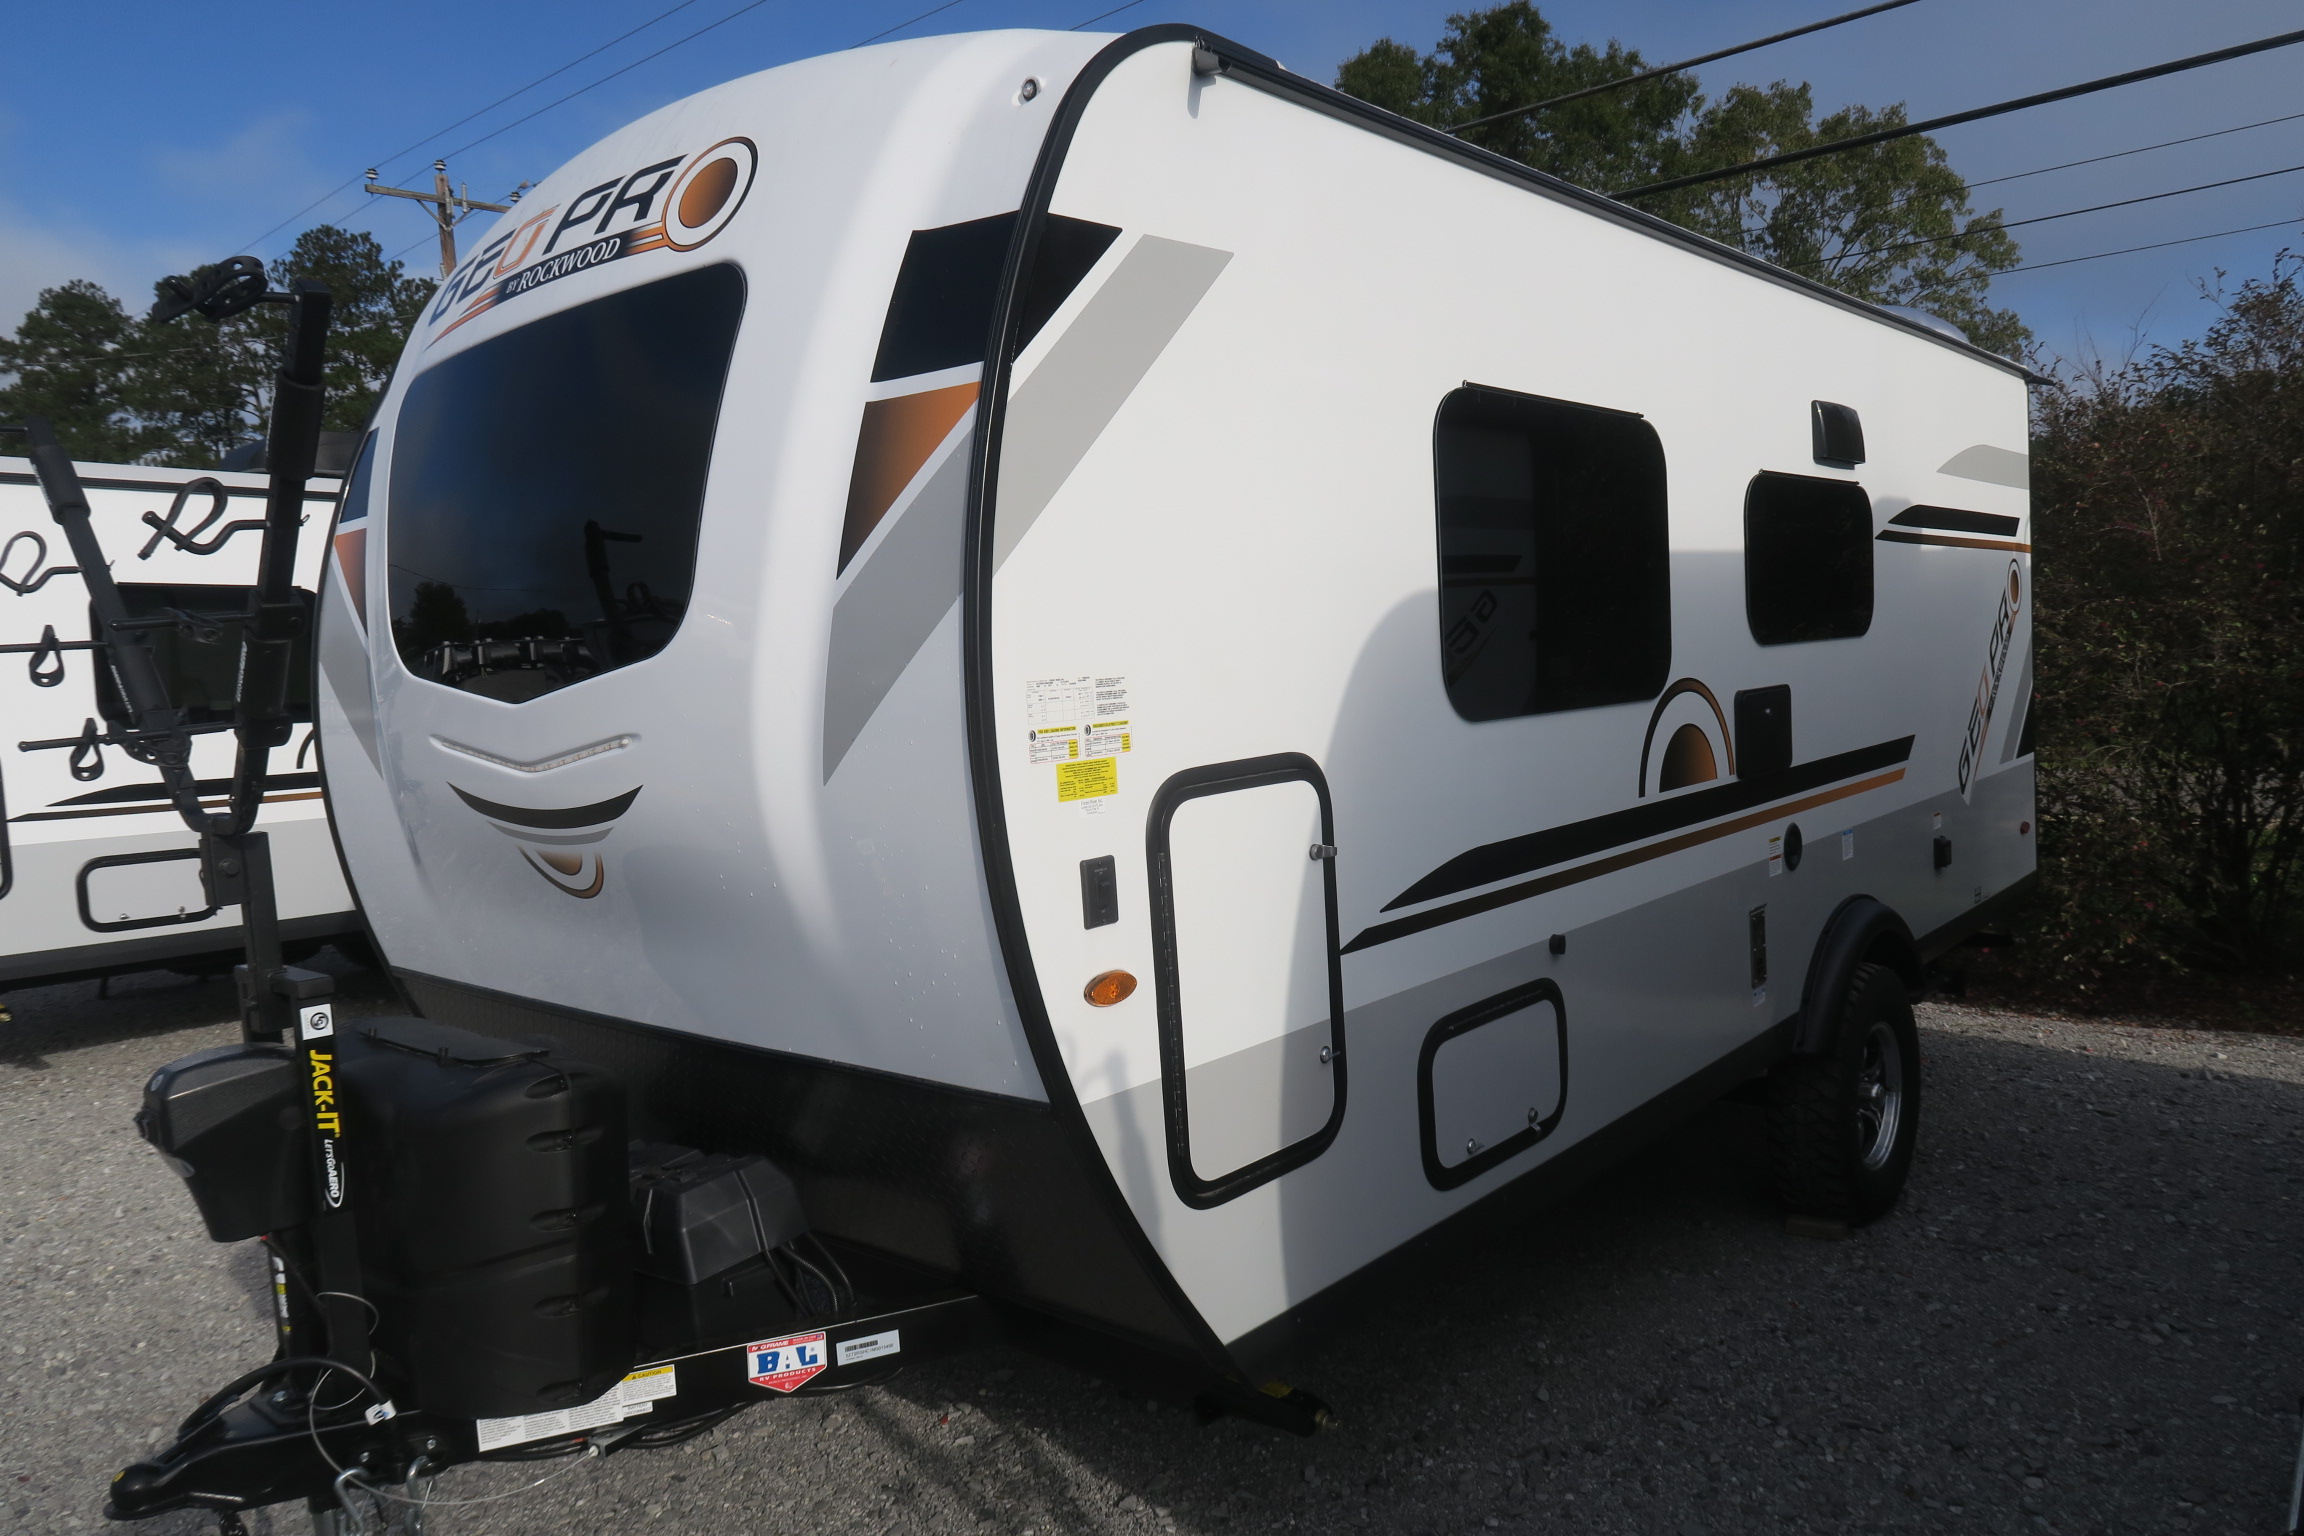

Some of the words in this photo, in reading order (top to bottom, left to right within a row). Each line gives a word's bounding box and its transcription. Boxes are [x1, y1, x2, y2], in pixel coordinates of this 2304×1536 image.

[505, 278, 520, 294] BY
[517, 238, 621, 293] ROCKWOOD
[757, 1345, 818, 1375] BAL
[637, 1370, 662, 1379] CAUTION
[772, 1367, 816, 1380] PRODUCTS
